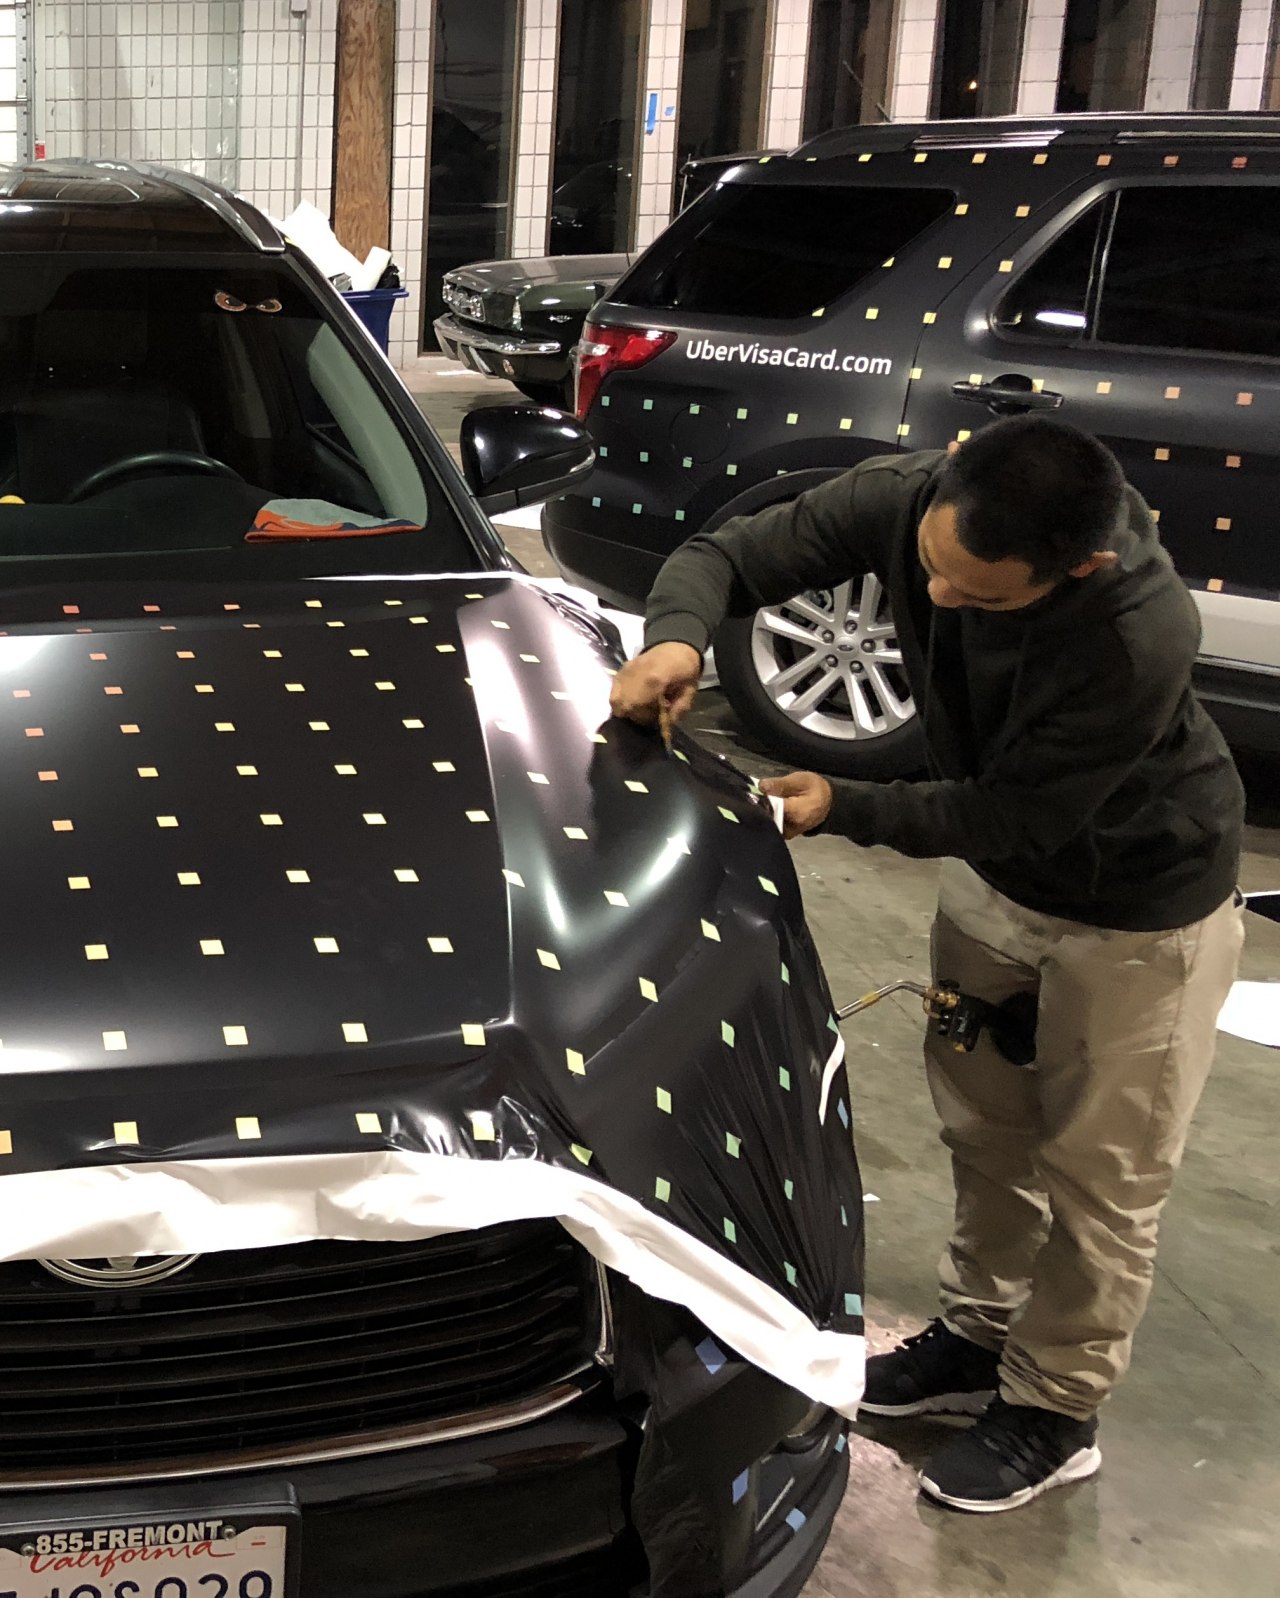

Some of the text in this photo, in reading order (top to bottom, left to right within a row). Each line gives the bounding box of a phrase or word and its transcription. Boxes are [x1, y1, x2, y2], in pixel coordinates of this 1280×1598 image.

[686, 339, 892, 375] UberVisaCard.com
[36, 1520, 223, 1555] 855-FREMONT
[30, 1540, 236, 1578] California
